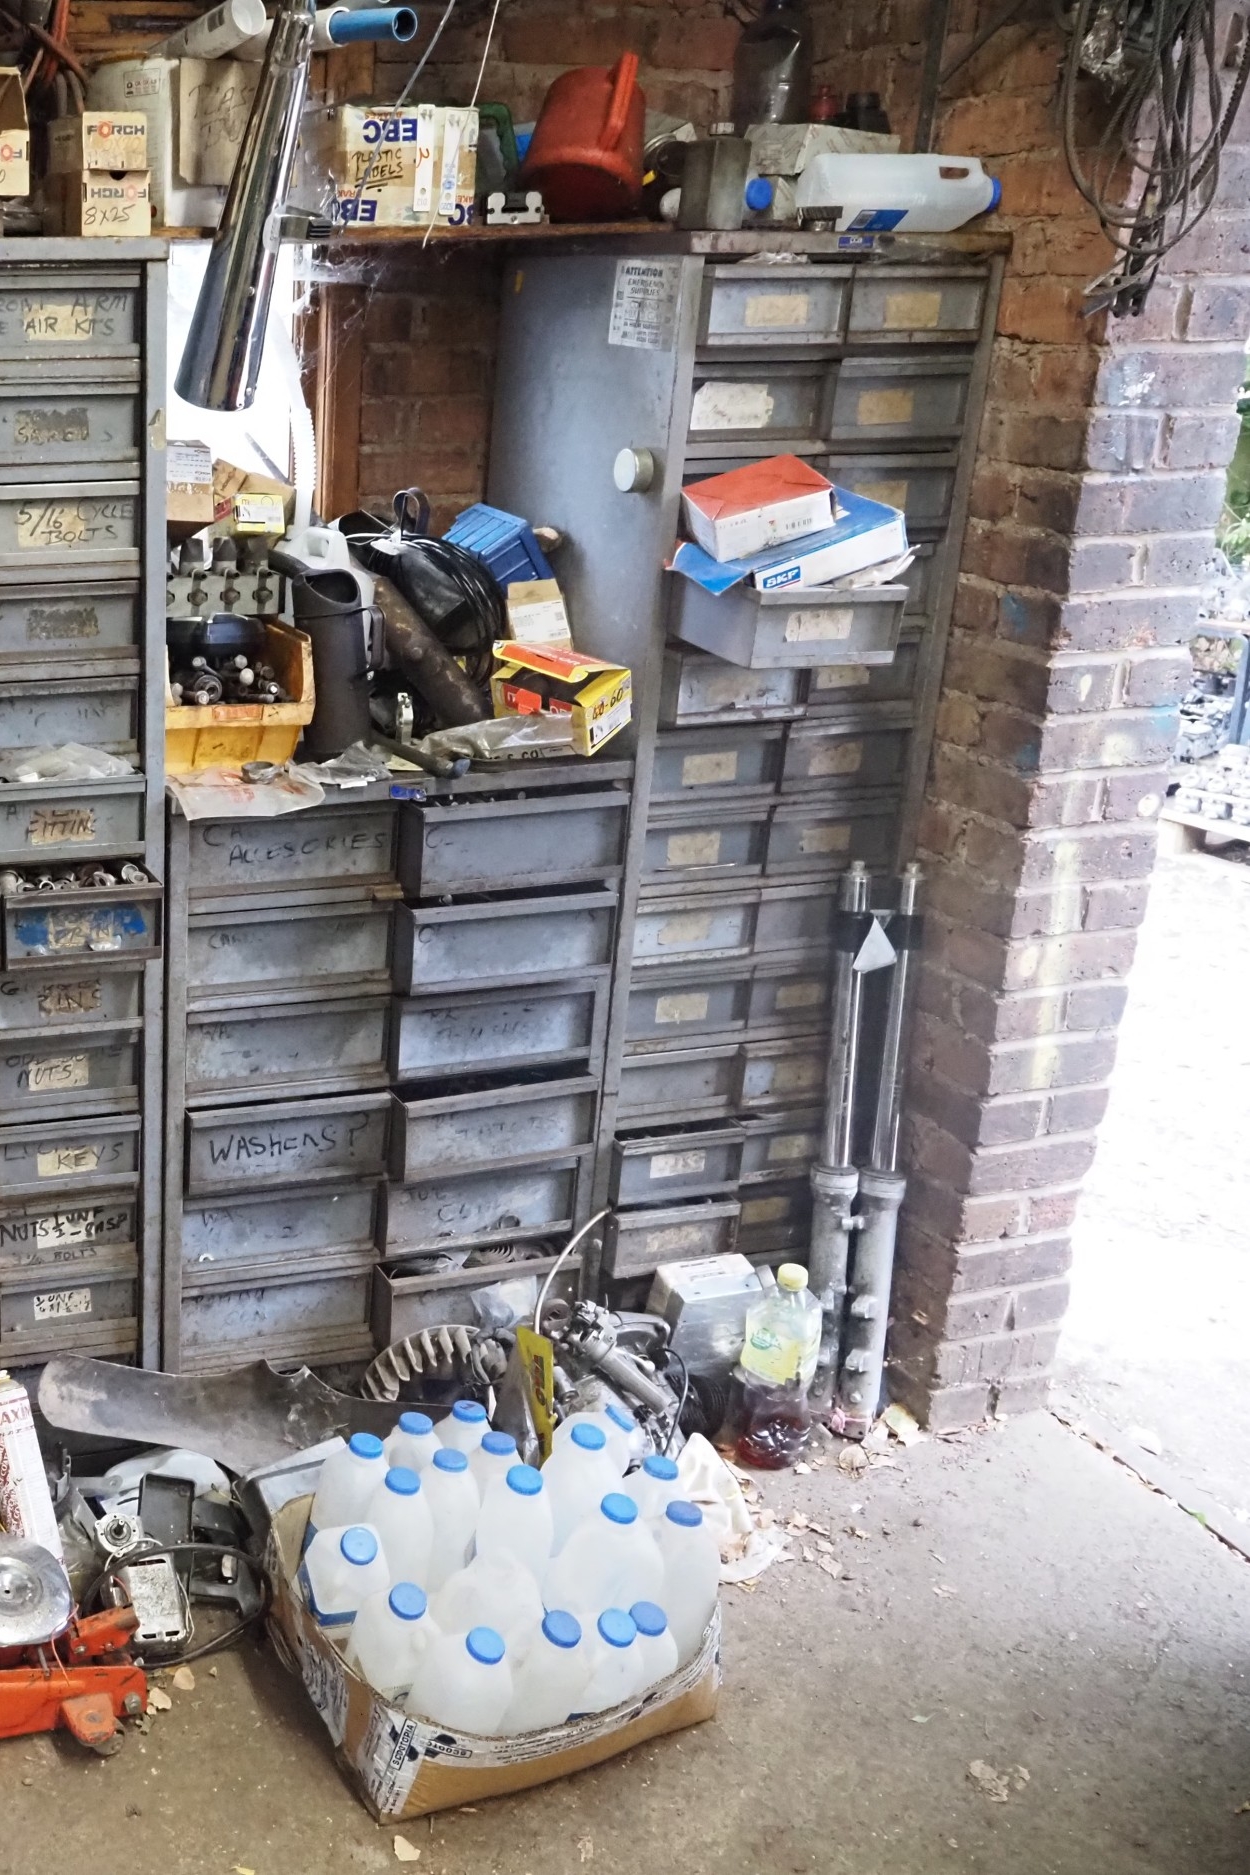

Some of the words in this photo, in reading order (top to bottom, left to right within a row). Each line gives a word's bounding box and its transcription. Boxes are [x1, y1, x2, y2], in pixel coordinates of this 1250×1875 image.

[363, 118, 418, 143] EBC
[352, 149, 402, 174] PLASTIC
[84, 204, 134, 226] 8X25
[626, 266, 664, 277] ATTENTION
[71, 292, 128, 317] ARM
[18, 500, 63, 536] 5/16
[46, 526, 119, 546] BOLTS
[766, 568, 800, 588] SKF
[26, 815, 96, 839] FITTIN
[56, 1142, 124, 1170] KEYS
[0, 1219, 50, 1248] NUTS
[53, 1246, 98, 1262] BOLTS
